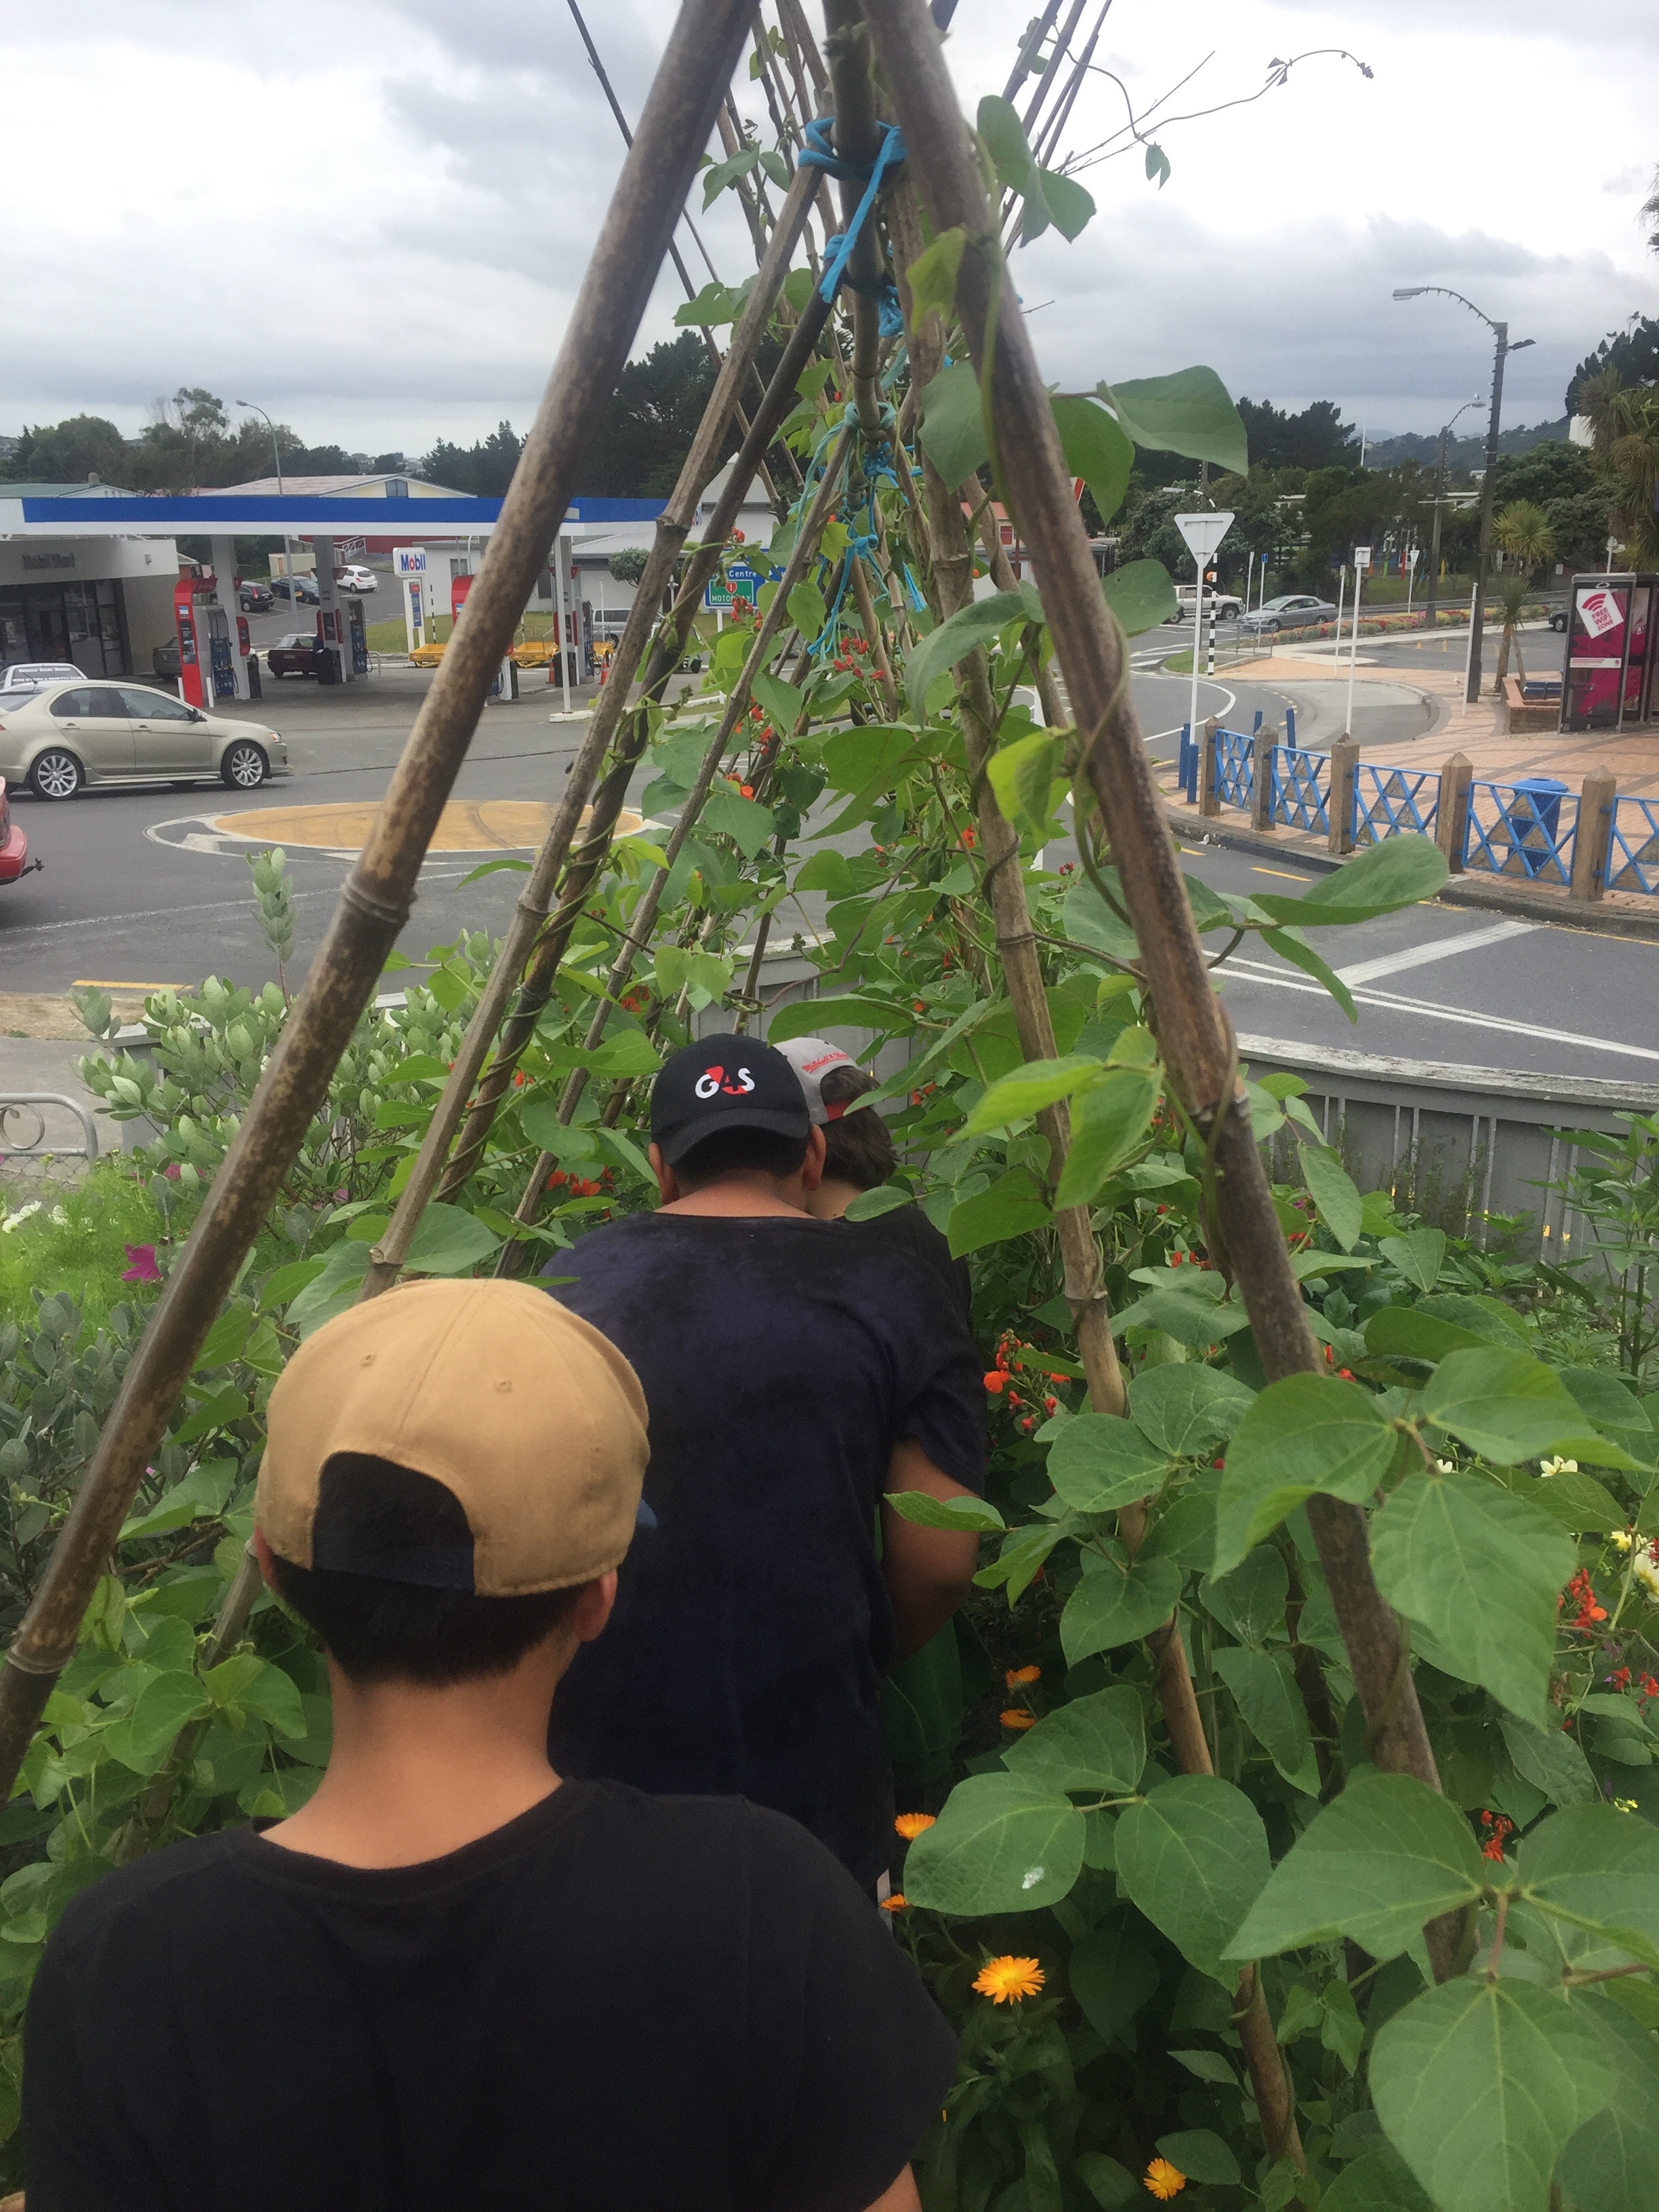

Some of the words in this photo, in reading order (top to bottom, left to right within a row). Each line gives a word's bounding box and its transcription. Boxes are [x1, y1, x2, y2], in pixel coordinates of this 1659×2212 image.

[401, 554, 426, 571] Mobil
[712, 594, 752, 602] MOTORAY
[1592, 607, 1609, 619] FREE
[1597, 619, 1614, 631] ZONE
[695, 1065, 756, 1099] G4S
